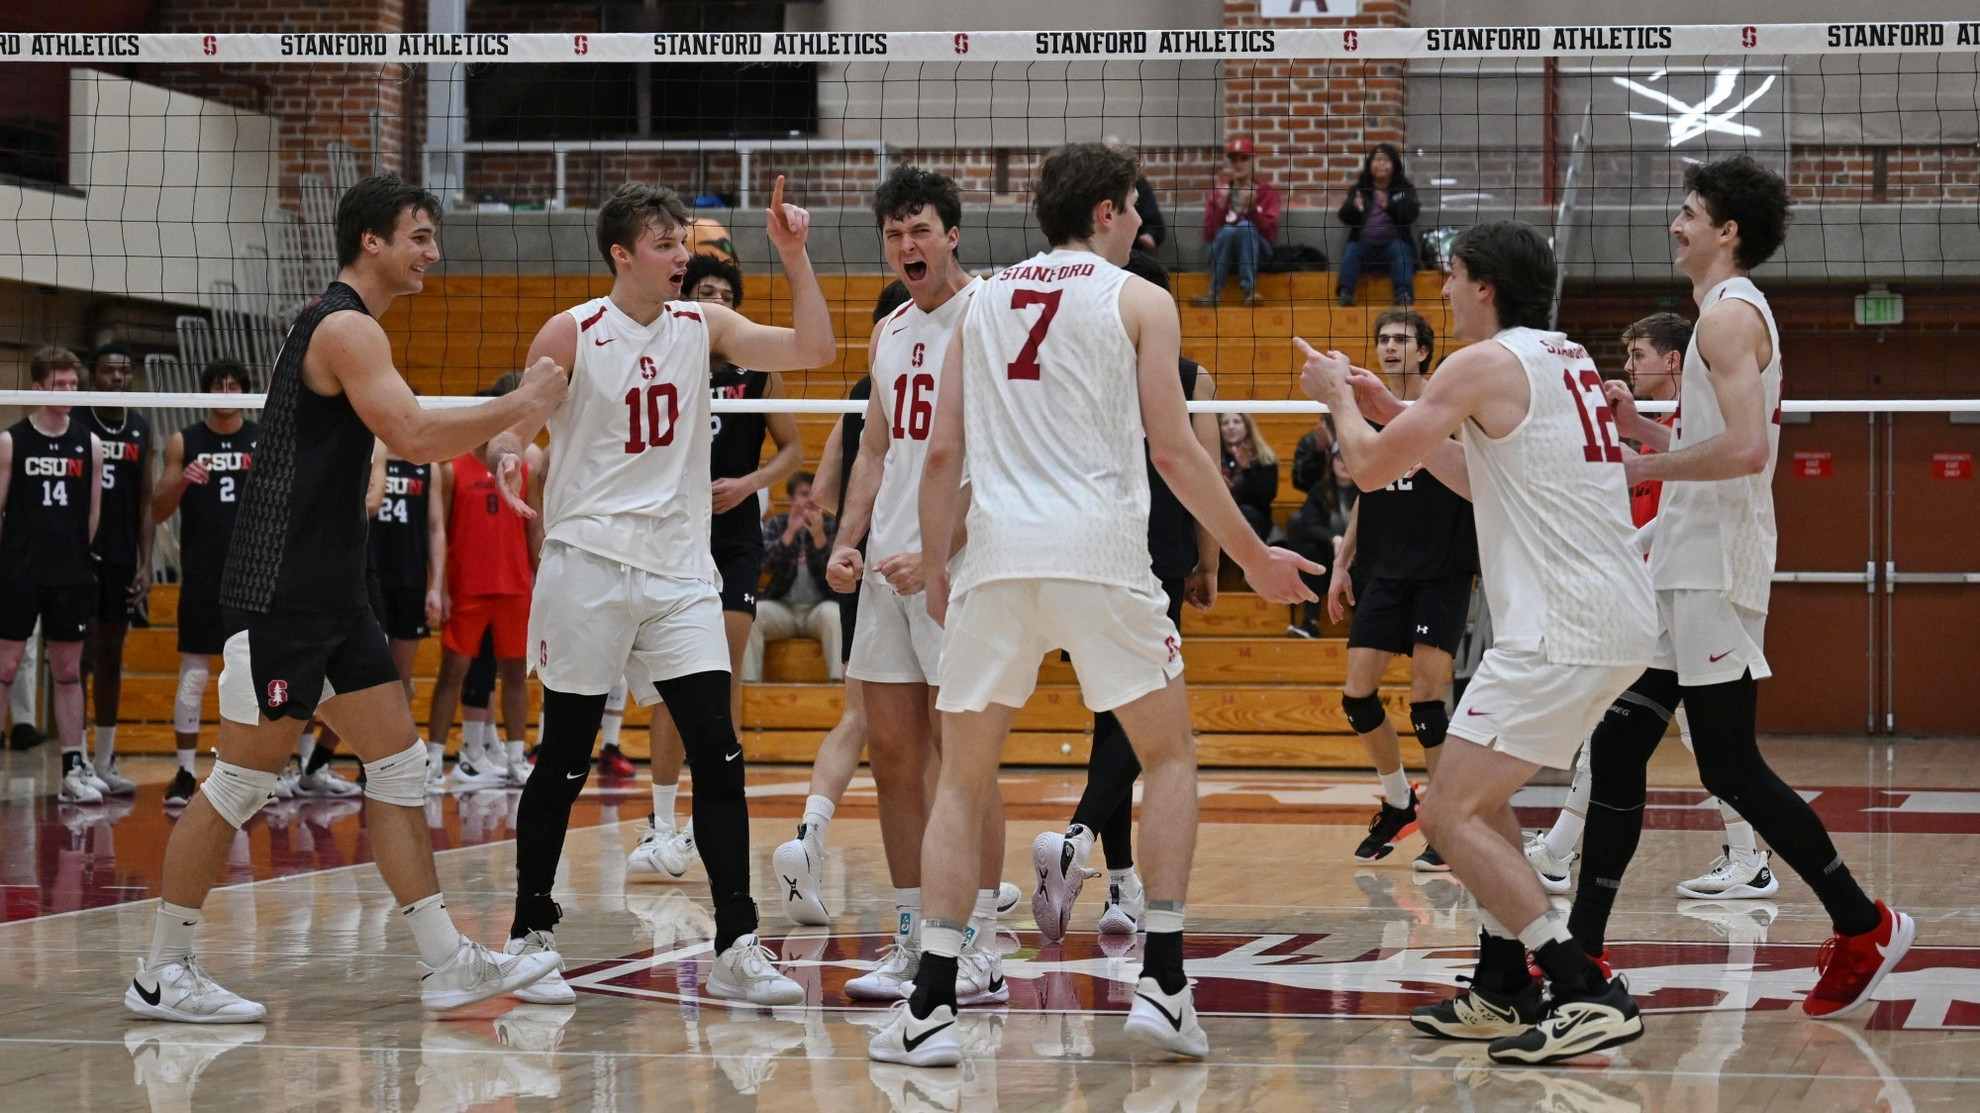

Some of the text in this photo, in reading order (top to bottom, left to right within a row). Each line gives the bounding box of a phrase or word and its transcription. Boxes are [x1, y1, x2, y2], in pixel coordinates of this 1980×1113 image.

[31, 34, 140, 56] ATHLETICS
[281, 34, 509, 56] STANFORD ATHLETICS
[653, 33, 888, 55] STANFORD ATHLETICS
[1035, 30, 1276, 54] STANFORD ATHLETICS
[1427, 26, 1672, 51] STANFORD ATHLETICS
[1828, 24, 1944, 47] STANFORD
[999, 263, 1095, 283] STANFORD
[1007, 289, 1064, 381] 7
[625, 382, 679, 454] 10
[892, 373, 935, 441] 16
[1563, 368, 1624, 463] 12
[101, 440, 139, 461] SUN
[25, 456, 84, 478] CSUN
[101, 464, 115, 489] 5
[42, 480, 68, 506] 14
[219, 476, 236, 502] 2
[385, 476, 424, 496] SUN
[378, 497, 408, 523] 24
